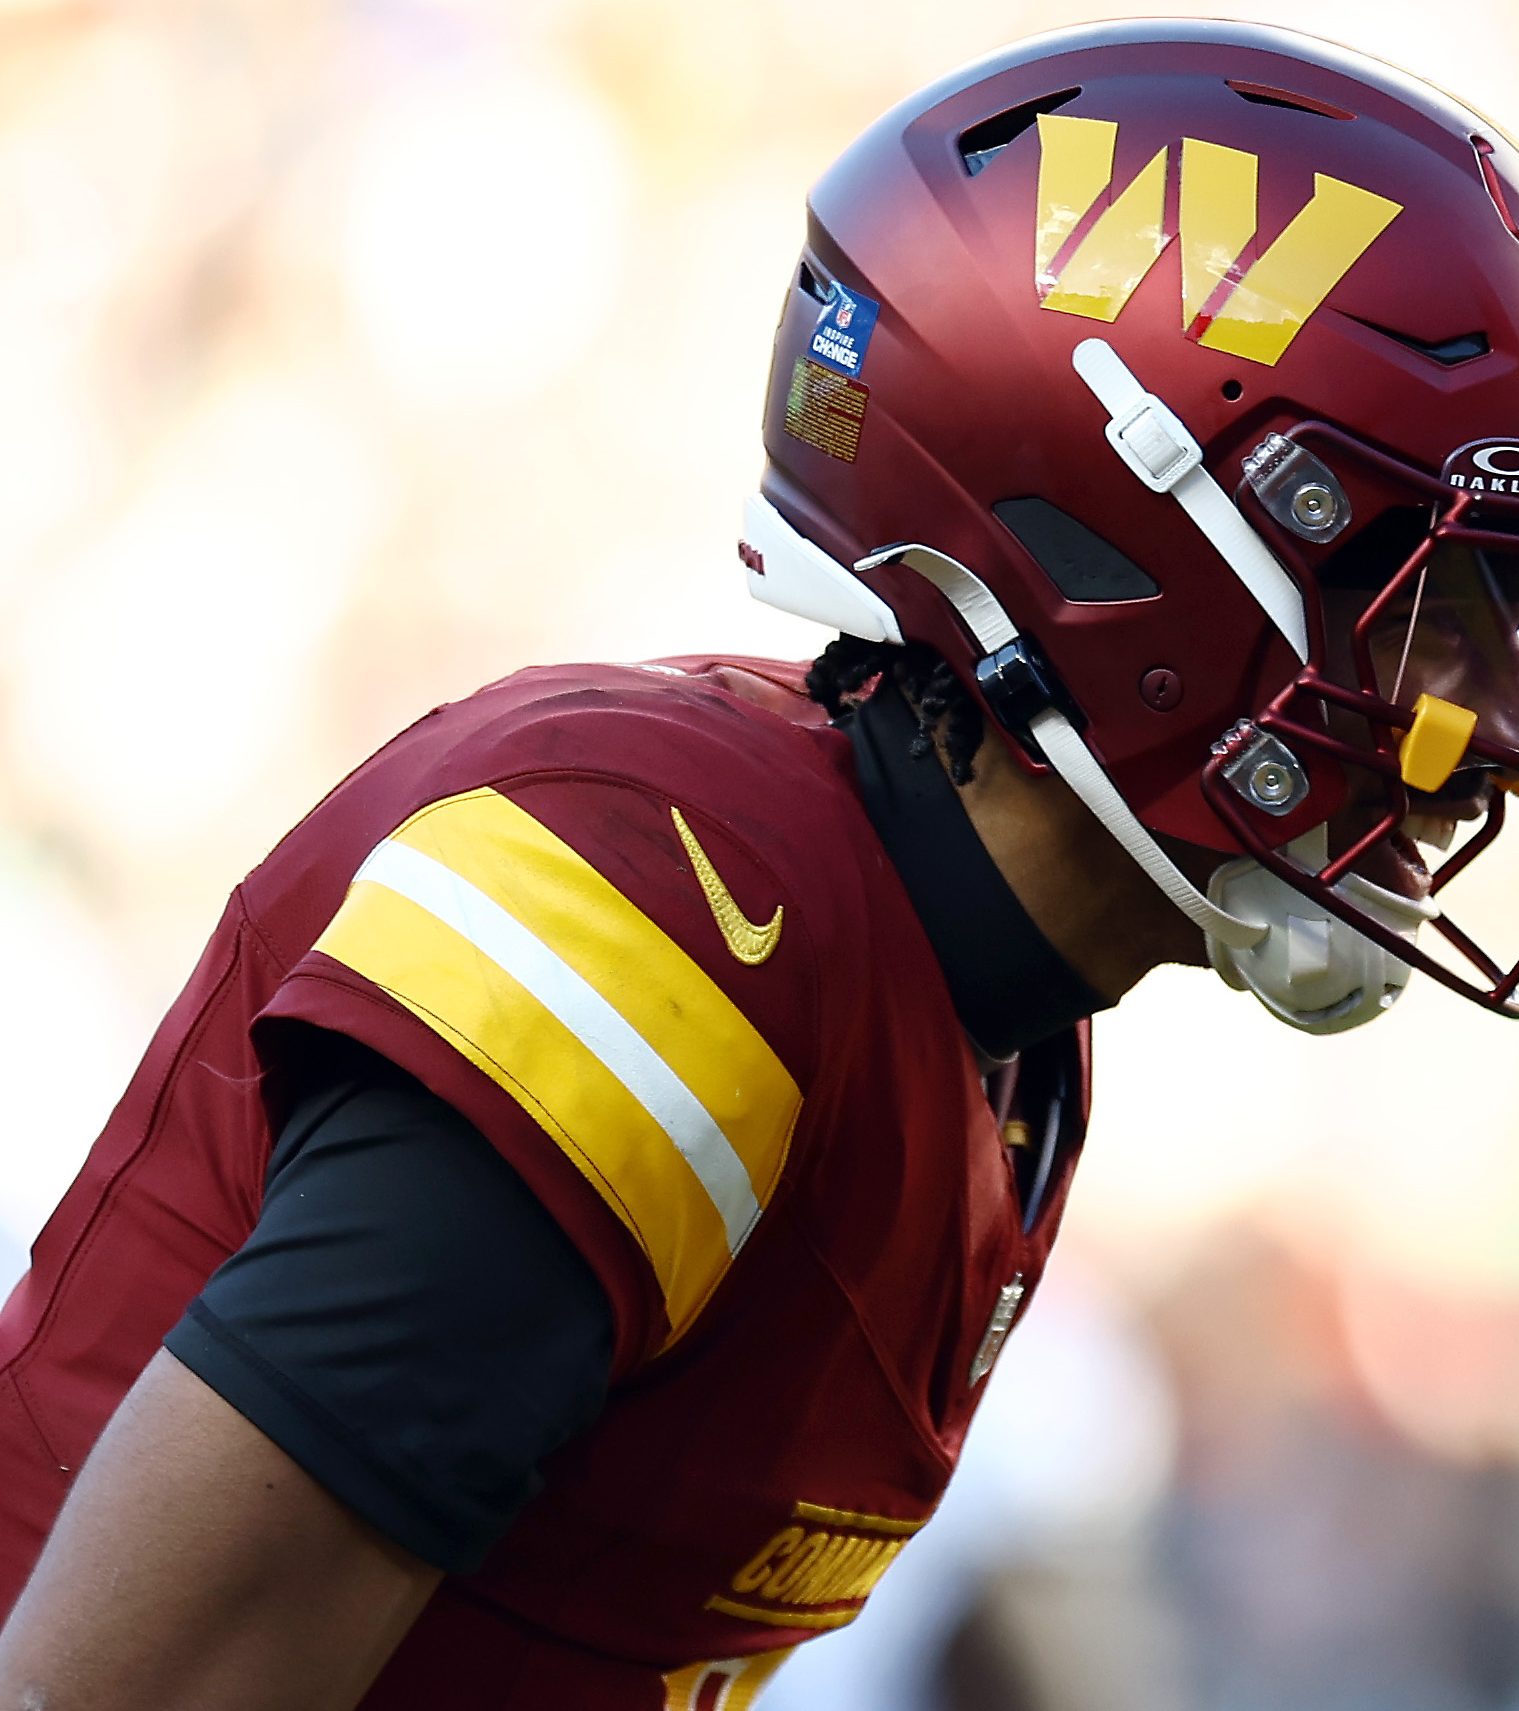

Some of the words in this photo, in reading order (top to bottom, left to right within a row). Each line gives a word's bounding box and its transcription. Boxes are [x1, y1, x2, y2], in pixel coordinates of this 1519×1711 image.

[1035, 113, 1404, 367] W
[811, 334, 859, 369] CHANGE
[822, 325, 855, 350] INSPIRE
